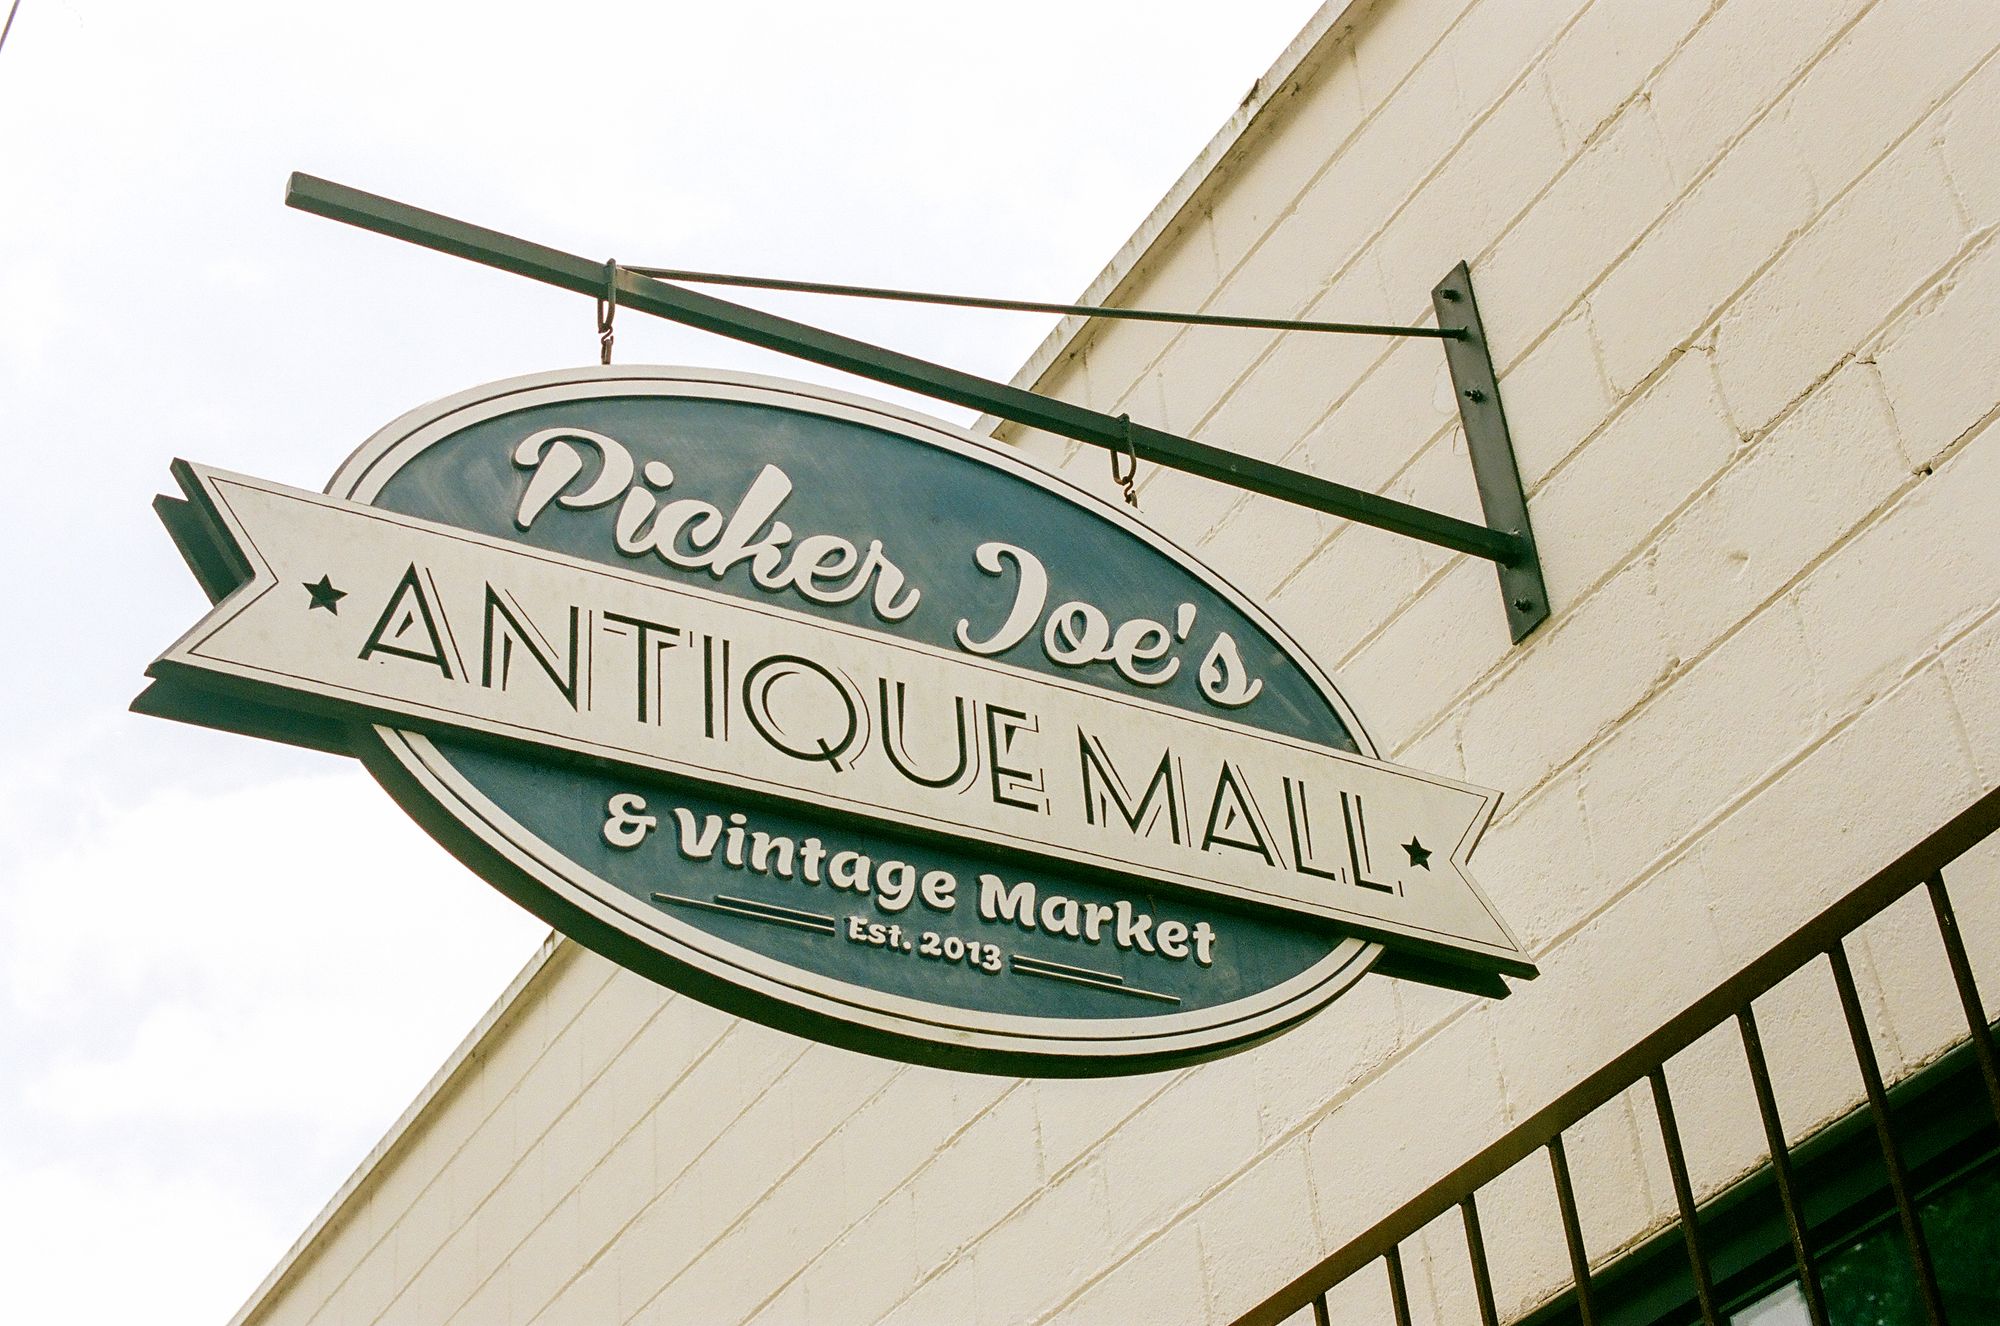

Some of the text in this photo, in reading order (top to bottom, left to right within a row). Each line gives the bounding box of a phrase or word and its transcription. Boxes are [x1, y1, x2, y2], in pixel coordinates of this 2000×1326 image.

[512, 427, 1263, 706] Picker Joe's
[357, 560, 1404, 897] ANTIQUE MALL
[603, 793, 1215, 966] & Vintage Market
[848, 915, 1002, 974] Est. 2013
